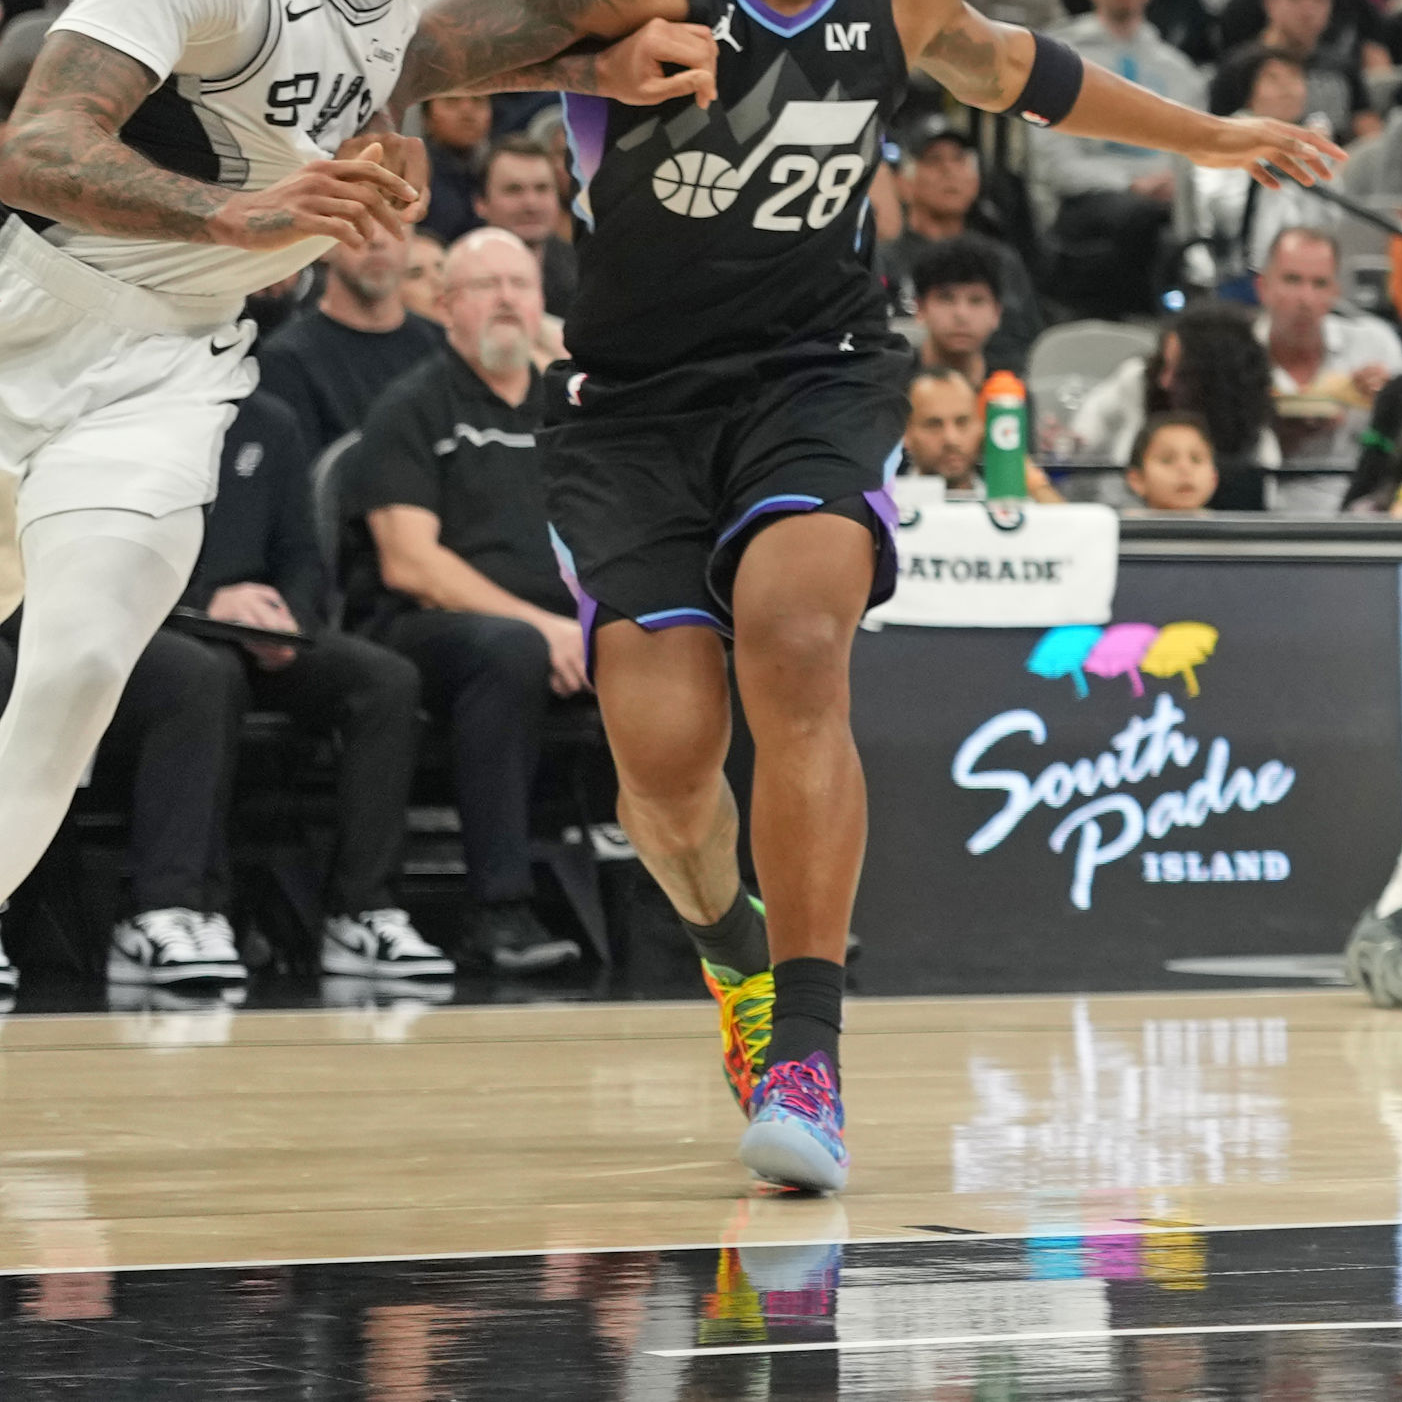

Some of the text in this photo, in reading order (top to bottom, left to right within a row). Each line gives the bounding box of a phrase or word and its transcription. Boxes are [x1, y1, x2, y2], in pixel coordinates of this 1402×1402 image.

[753, 154, 865, 231] 28
[898, 555, 1066, 583] ATORADE
[952, 692, 1199, 856] South
[1048, 737, 1297, 911] Padre
[1142, 850, 1292, 883] ISLAND
